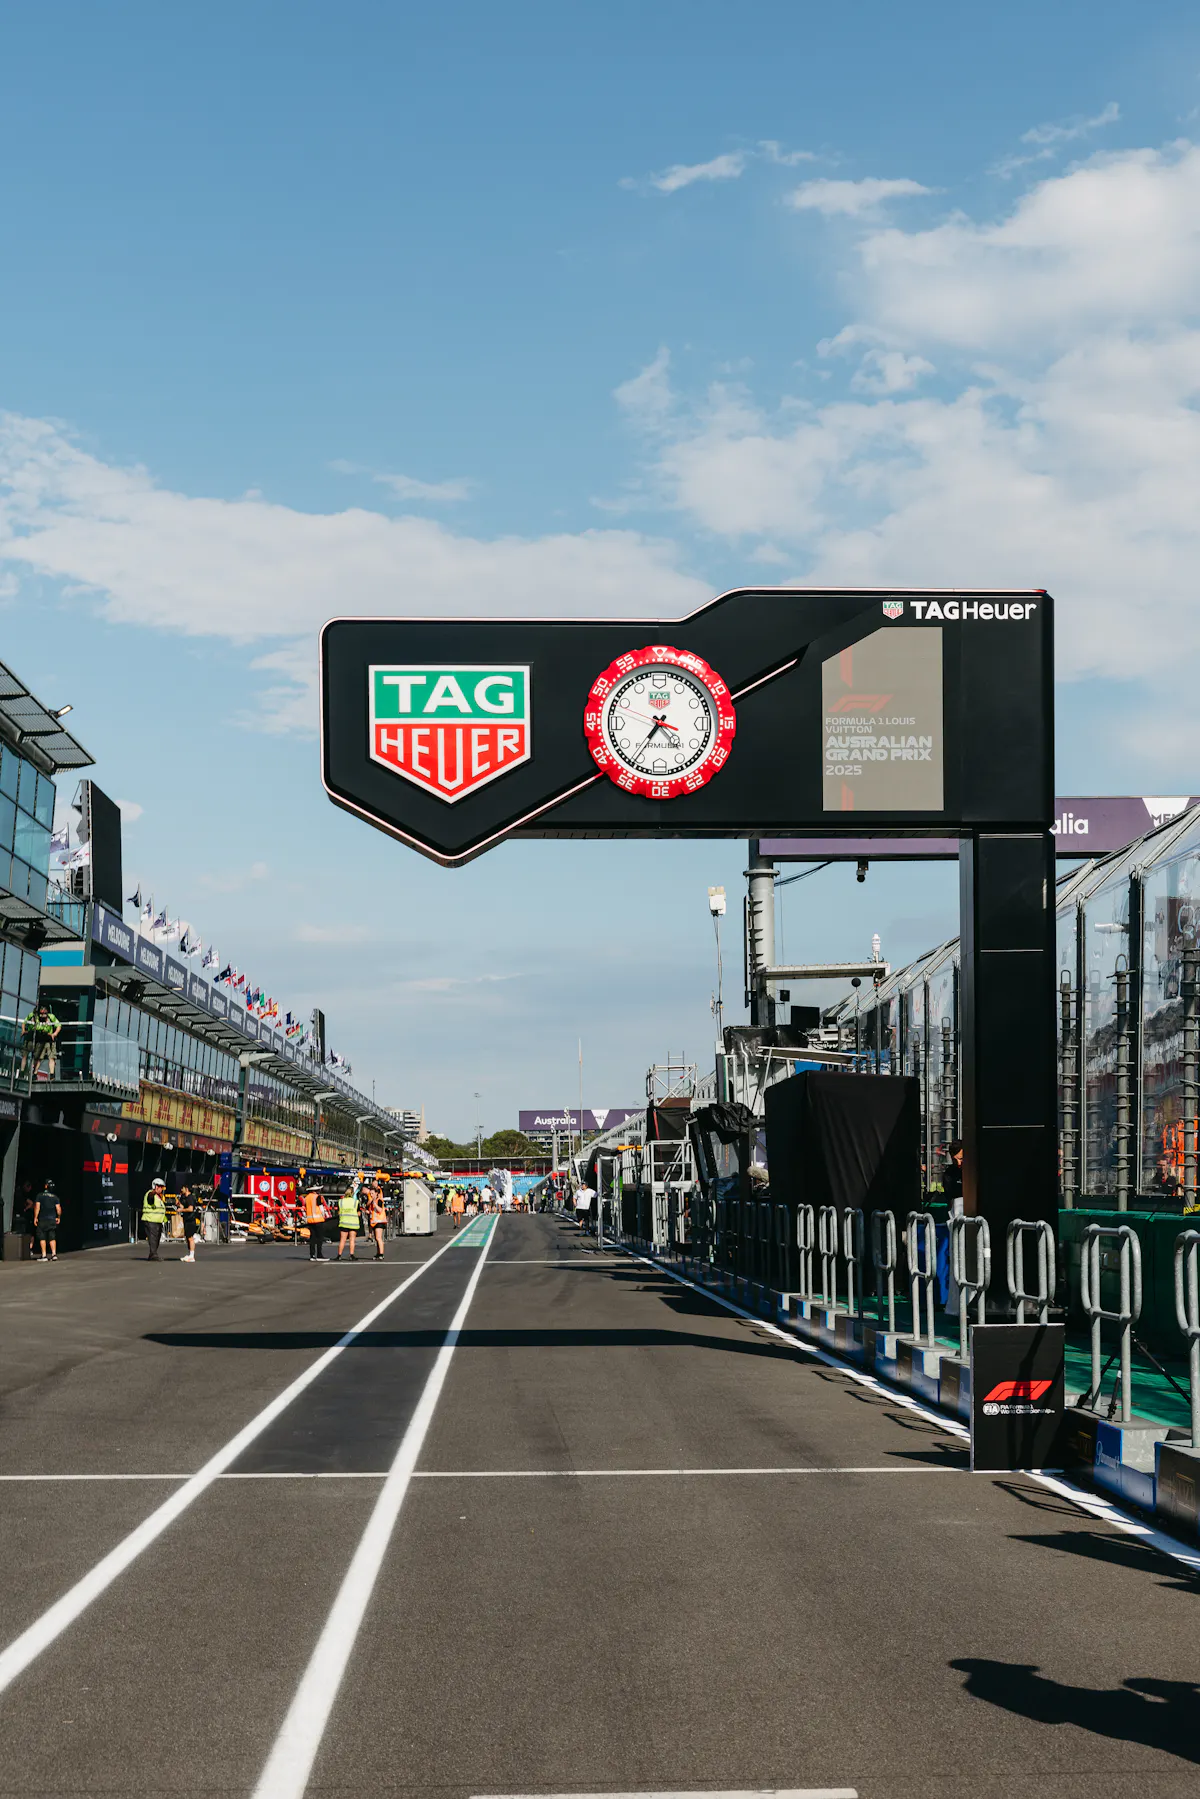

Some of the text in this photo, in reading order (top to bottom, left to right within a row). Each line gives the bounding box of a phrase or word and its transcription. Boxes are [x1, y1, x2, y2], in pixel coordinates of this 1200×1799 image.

[616, 654, 635, 670] 55
[382, 675, 514, 714] TAG
[592, 678, 608, 696] 50
[713, 680, 727, 695] 10
[586, 712, 597, 731] 45
[724, 716, 734, 729] 15
[825, 717, 916, 725] FORMULA 1 LOUIS
[826, 736, 932, 748] AUSTRALIAN
[380, 728, 520, 790] HEUER
[592, 747, 608, 764] 40
[712, 748, 727, 767] 20
[825, 749, 932, 760] GRAND PRIX
[825, 765, 862, 775] 2025
[617, 775, 635, 790] 35
[686, 775, 704, 790] 25
[651, 786, 670, 797] 30
[983, 1381, 1053, 1401] F1
